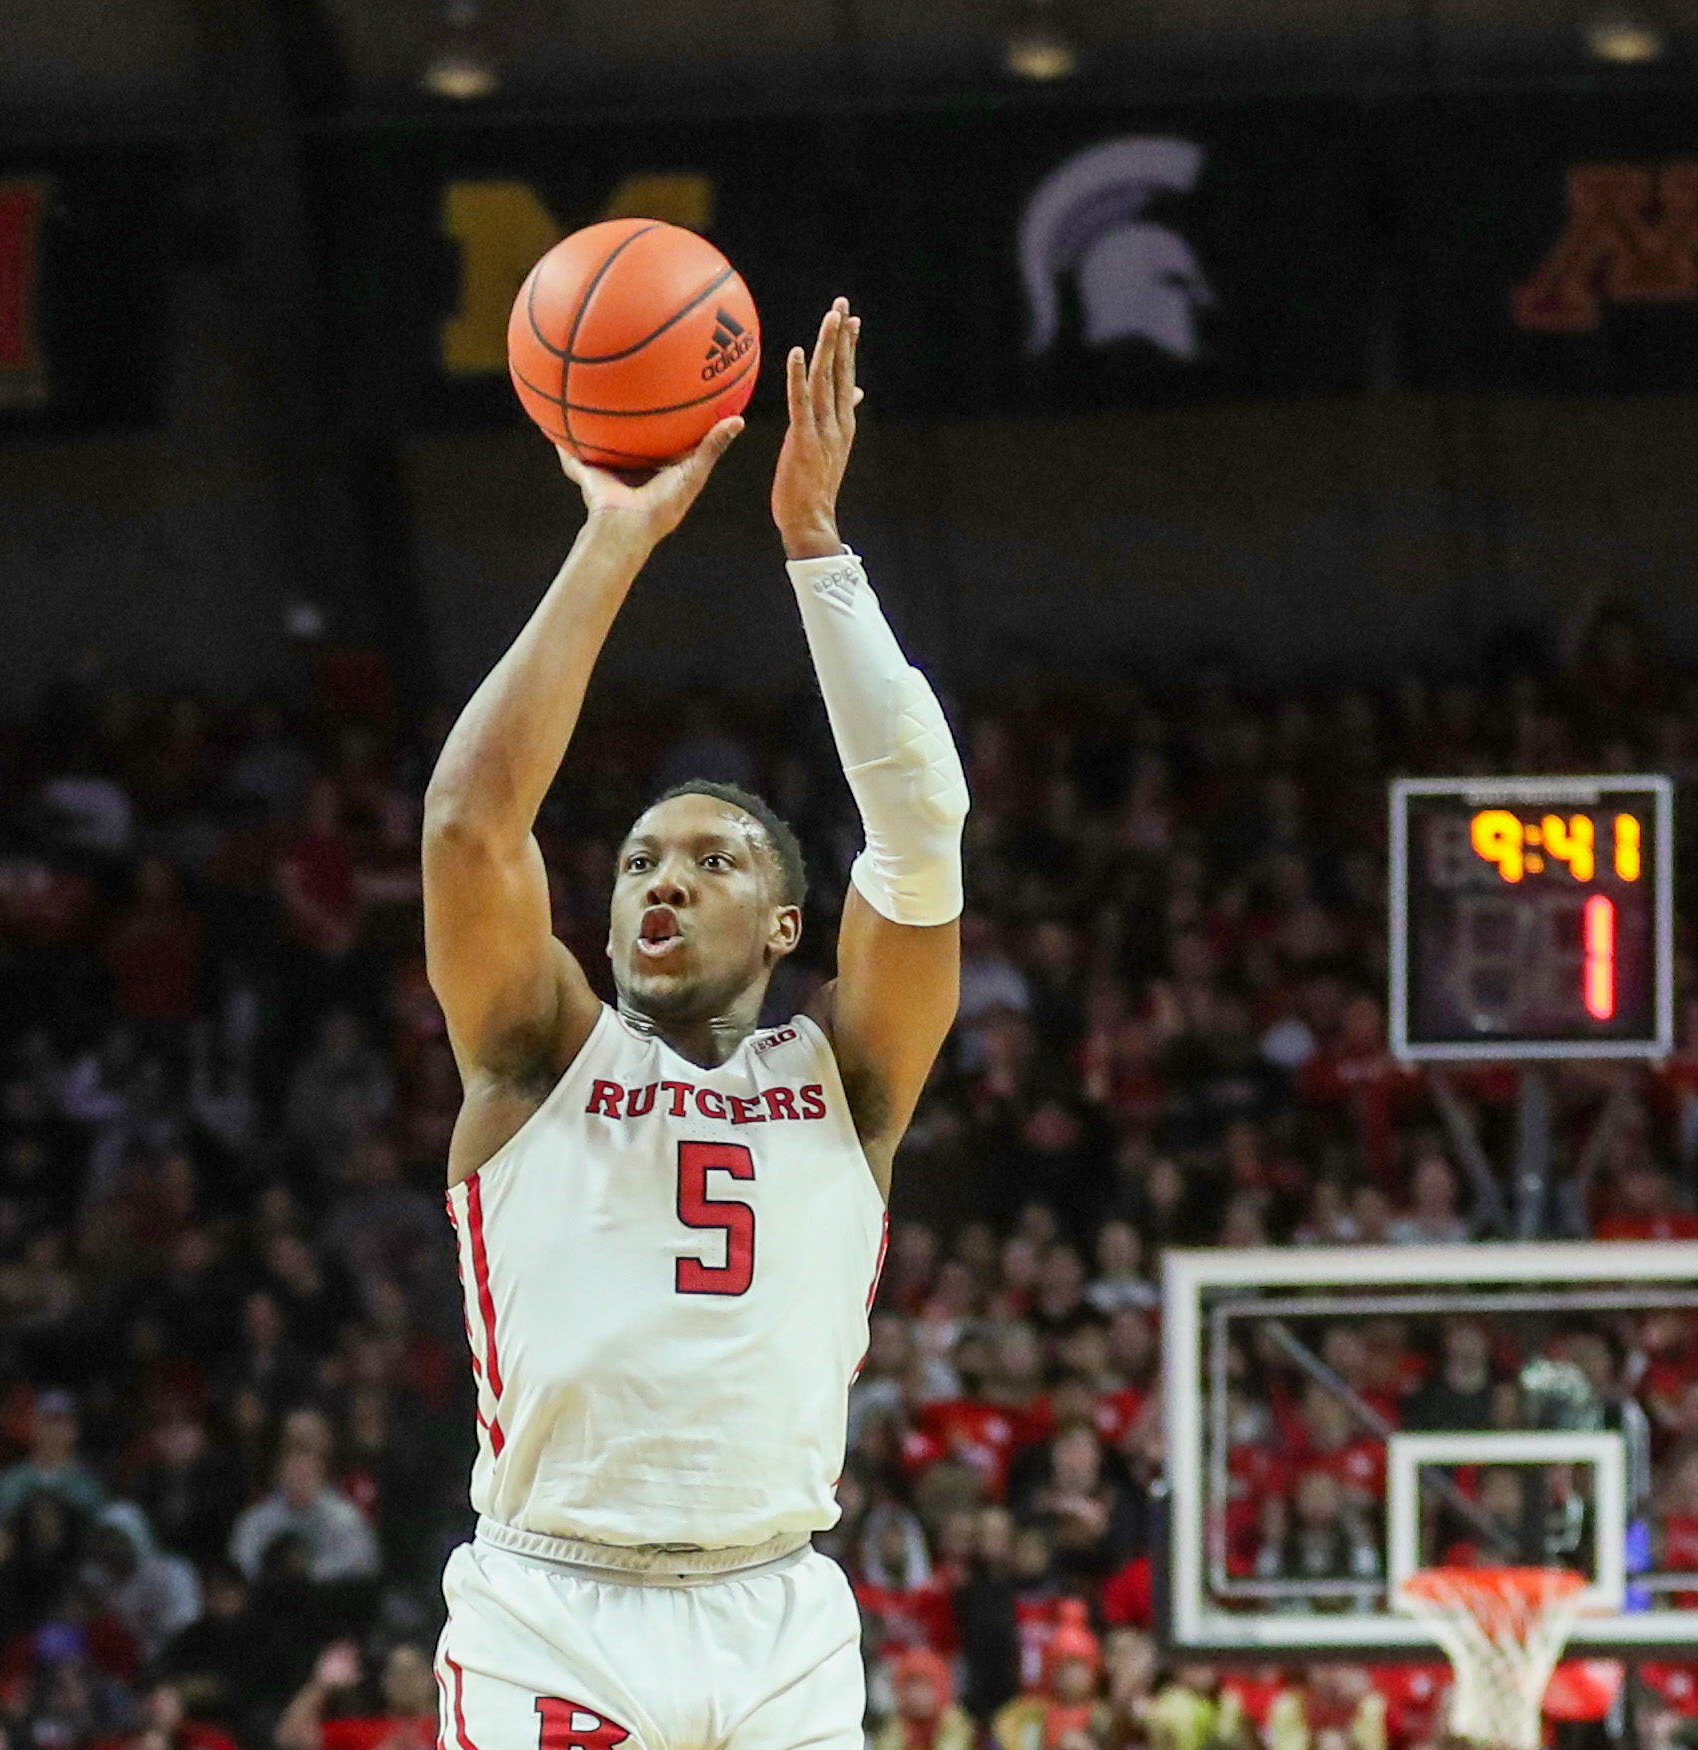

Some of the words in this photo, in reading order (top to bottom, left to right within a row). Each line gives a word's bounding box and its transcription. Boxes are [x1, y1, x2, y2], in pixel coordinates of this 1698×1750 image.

[1469, 809, 1642, 884] 9:41
[1583, 893, 1616, 1021] 1
[585, 1079, 828, 1124] RUTGERS
[675, 1139, 756, 1297] 5
